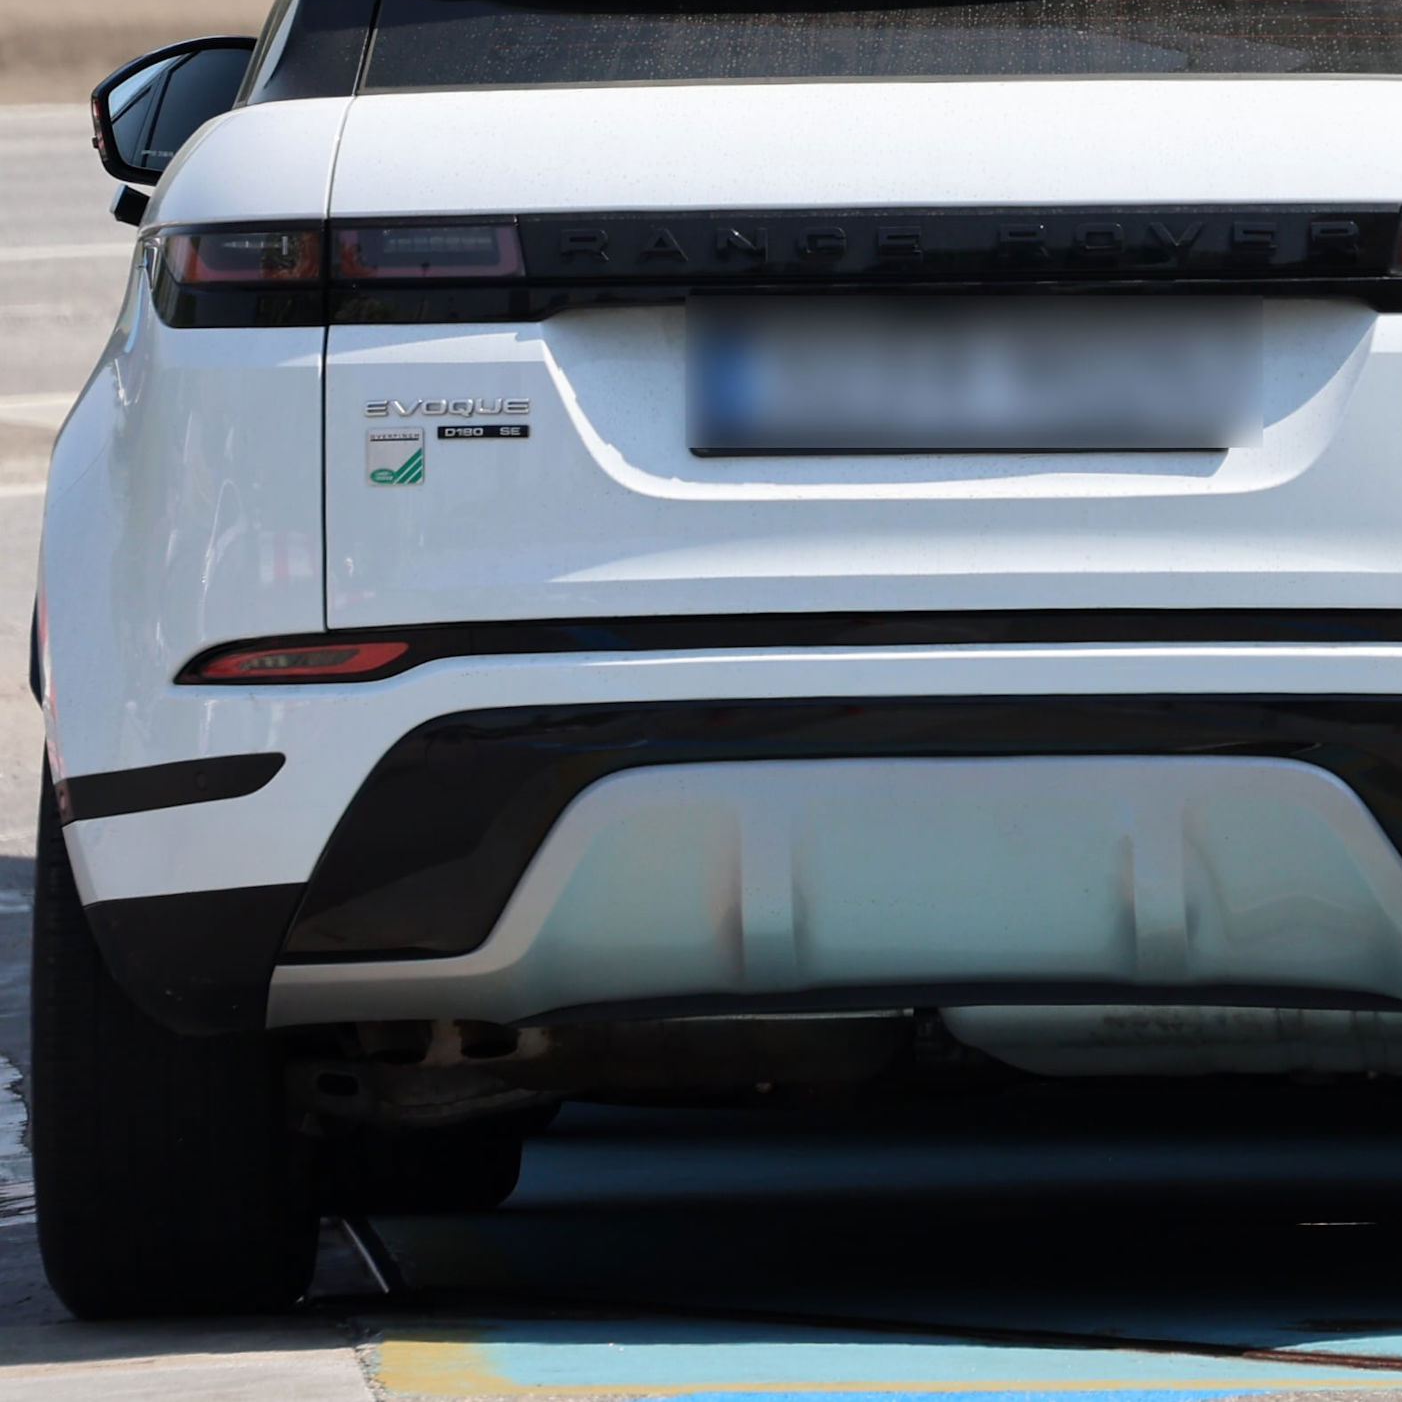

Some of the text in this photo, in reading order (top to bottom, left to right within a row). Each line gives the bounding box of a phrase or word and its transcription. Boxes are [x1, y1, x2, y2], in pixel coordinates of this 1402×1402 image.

[558, 220, 1362, 264] RANGE ROVER
[364, 398, 531, 418] EVOQUE
[444, 427, 521, 437] D180 SE
